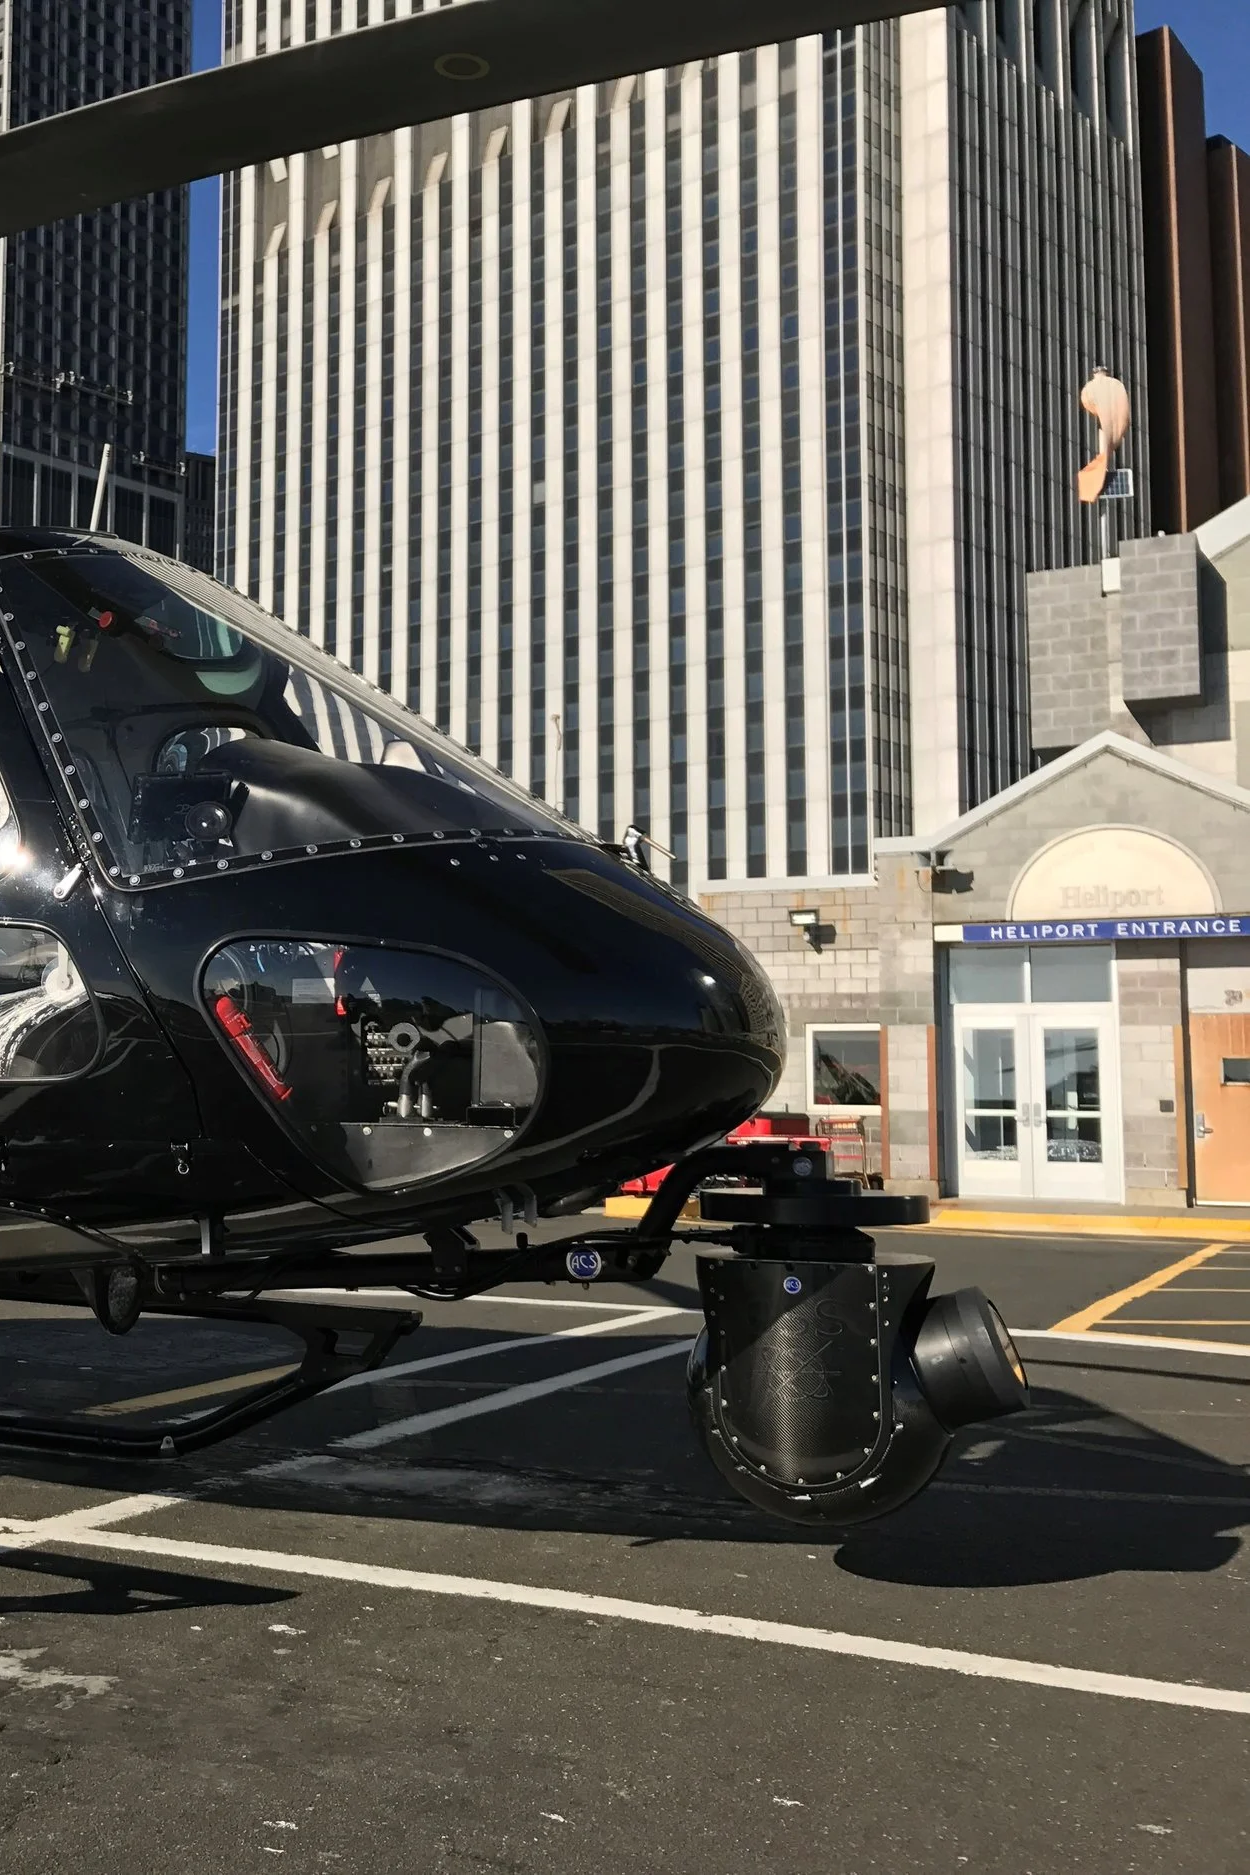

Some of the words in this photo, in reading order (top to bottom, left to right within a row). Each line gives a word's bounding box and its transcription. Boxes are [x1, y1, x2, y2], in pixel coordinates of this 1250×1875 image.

[1060, 885, 1164, 913] Heliport
[990, 924, 1098, 940] HELIPORT
[1117, 919, 1241, 936] ENTRANCE
[571, 1255, 597, 1269] ACS
